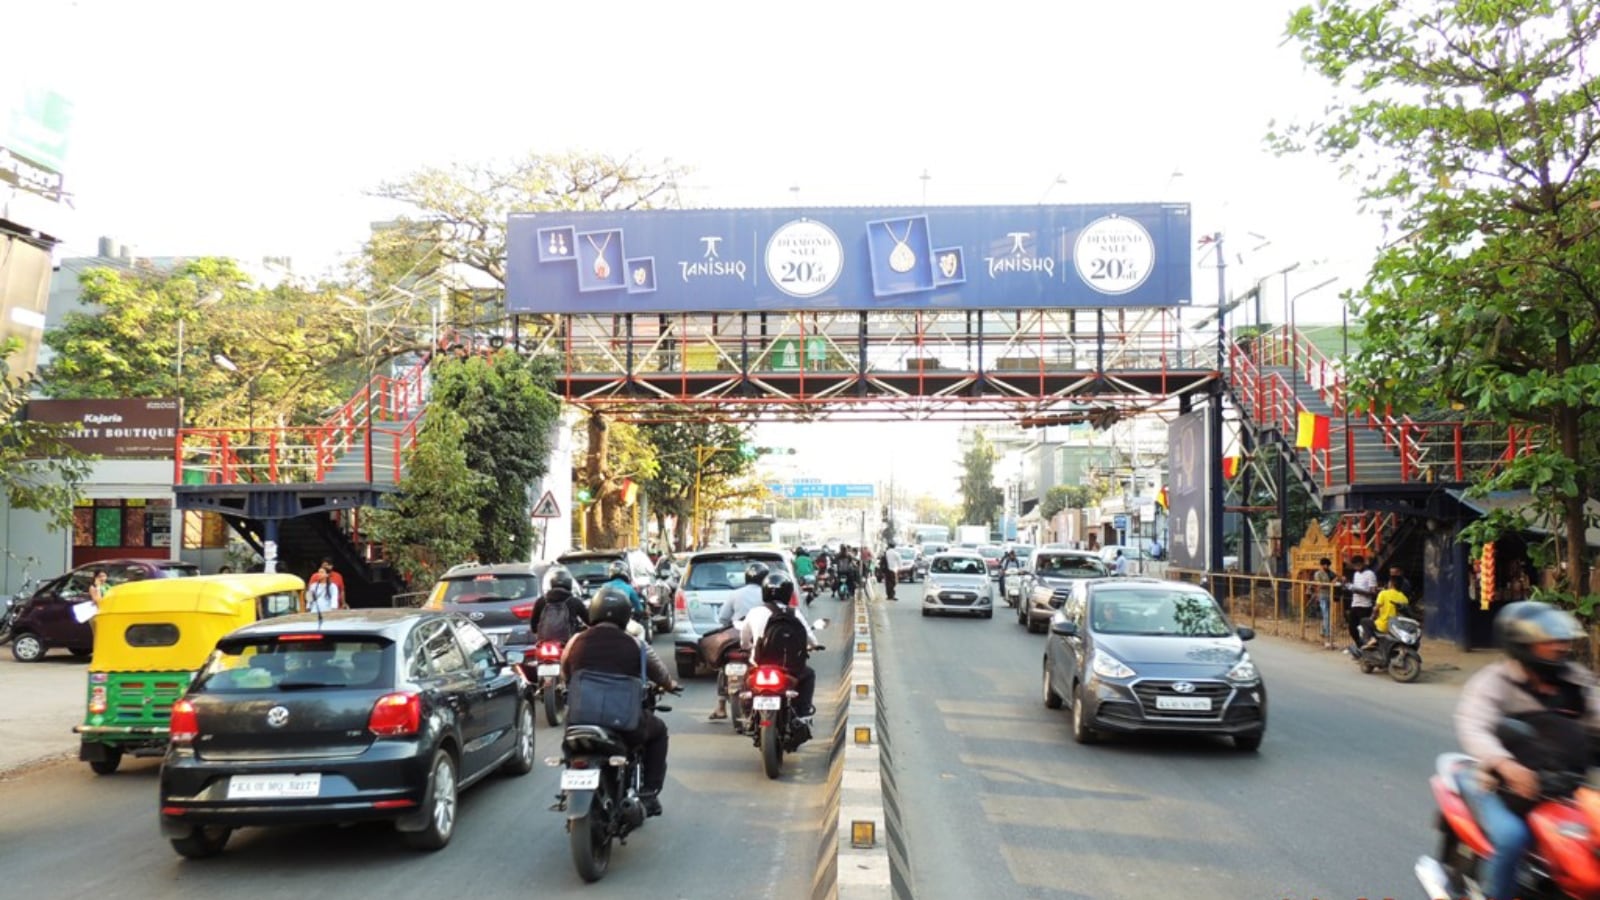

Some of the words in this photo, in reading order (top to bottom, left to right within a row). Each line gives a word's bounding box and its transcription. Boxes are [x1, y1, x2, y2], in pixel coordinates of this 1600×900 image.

[778, 238, 831, 247] DIAMOND
[1087, 234, 1142, 244] DIAMOND
[790, 248, 815, 256] SALE
[1101, 244, 1126, 253] SALE
[84, 413, 122, 424] Kajaria
[105, 428, 176, 440] BOUTIQUE
